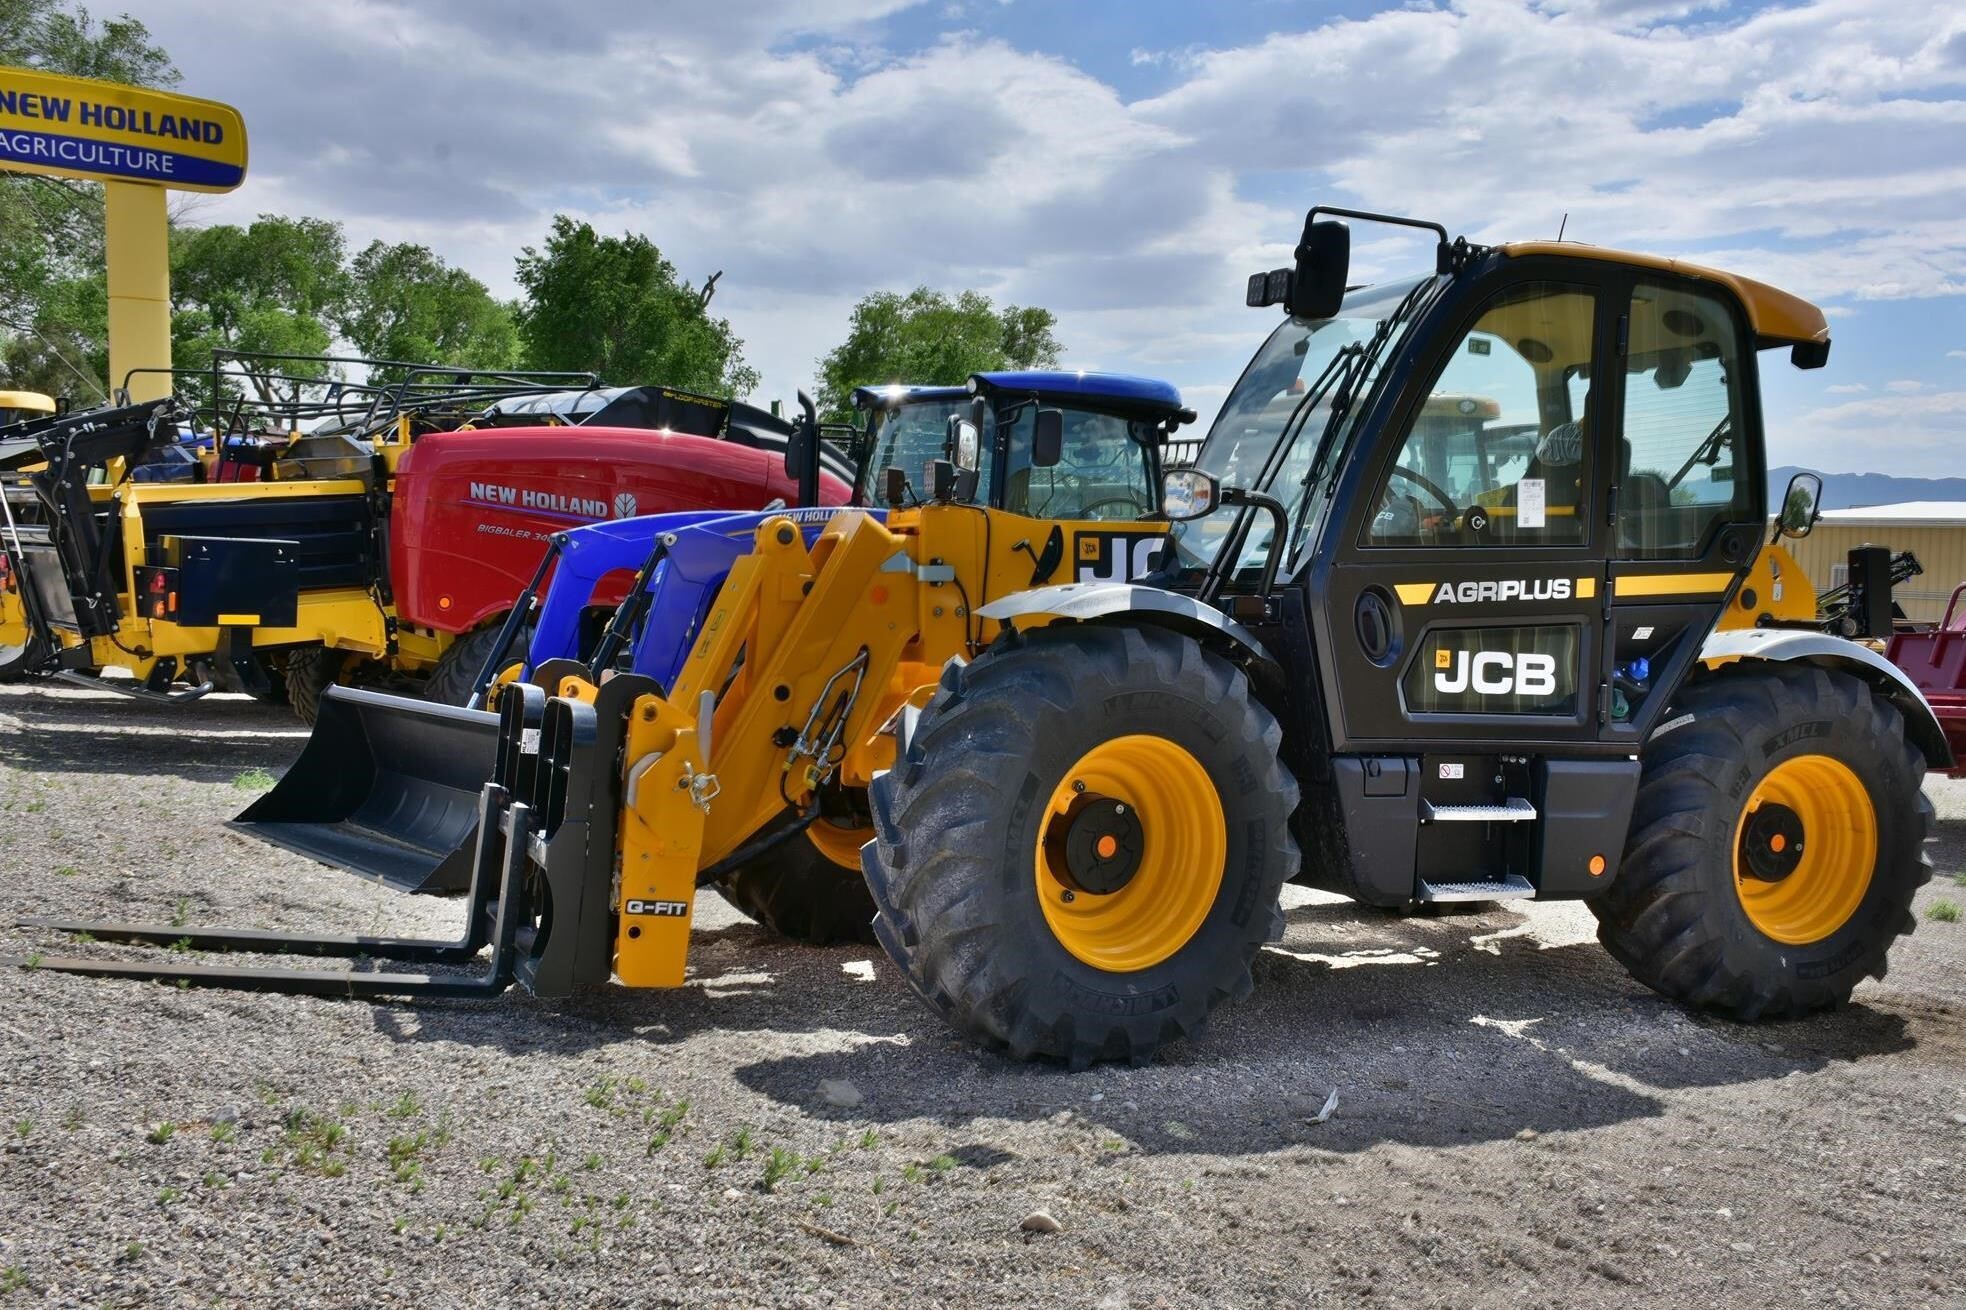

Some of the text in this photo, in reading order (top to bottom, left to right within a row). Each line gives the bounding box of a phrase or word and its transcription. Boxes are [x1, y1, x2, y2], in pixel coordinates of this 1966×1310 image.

[0, 89, 223, 145] NEW HOLLAND
[0, 131, 174, 174] AGRICULTURE
[470, 482, 608, 518] NEW HOLLAND
[477, 524, 531, 539] BIGBALER
[1434, 578, 1571, 604] AGRIPLUS
[1434, 650, 1556, 696] JCB
[626, 900, 687, 916] Q-FIT
